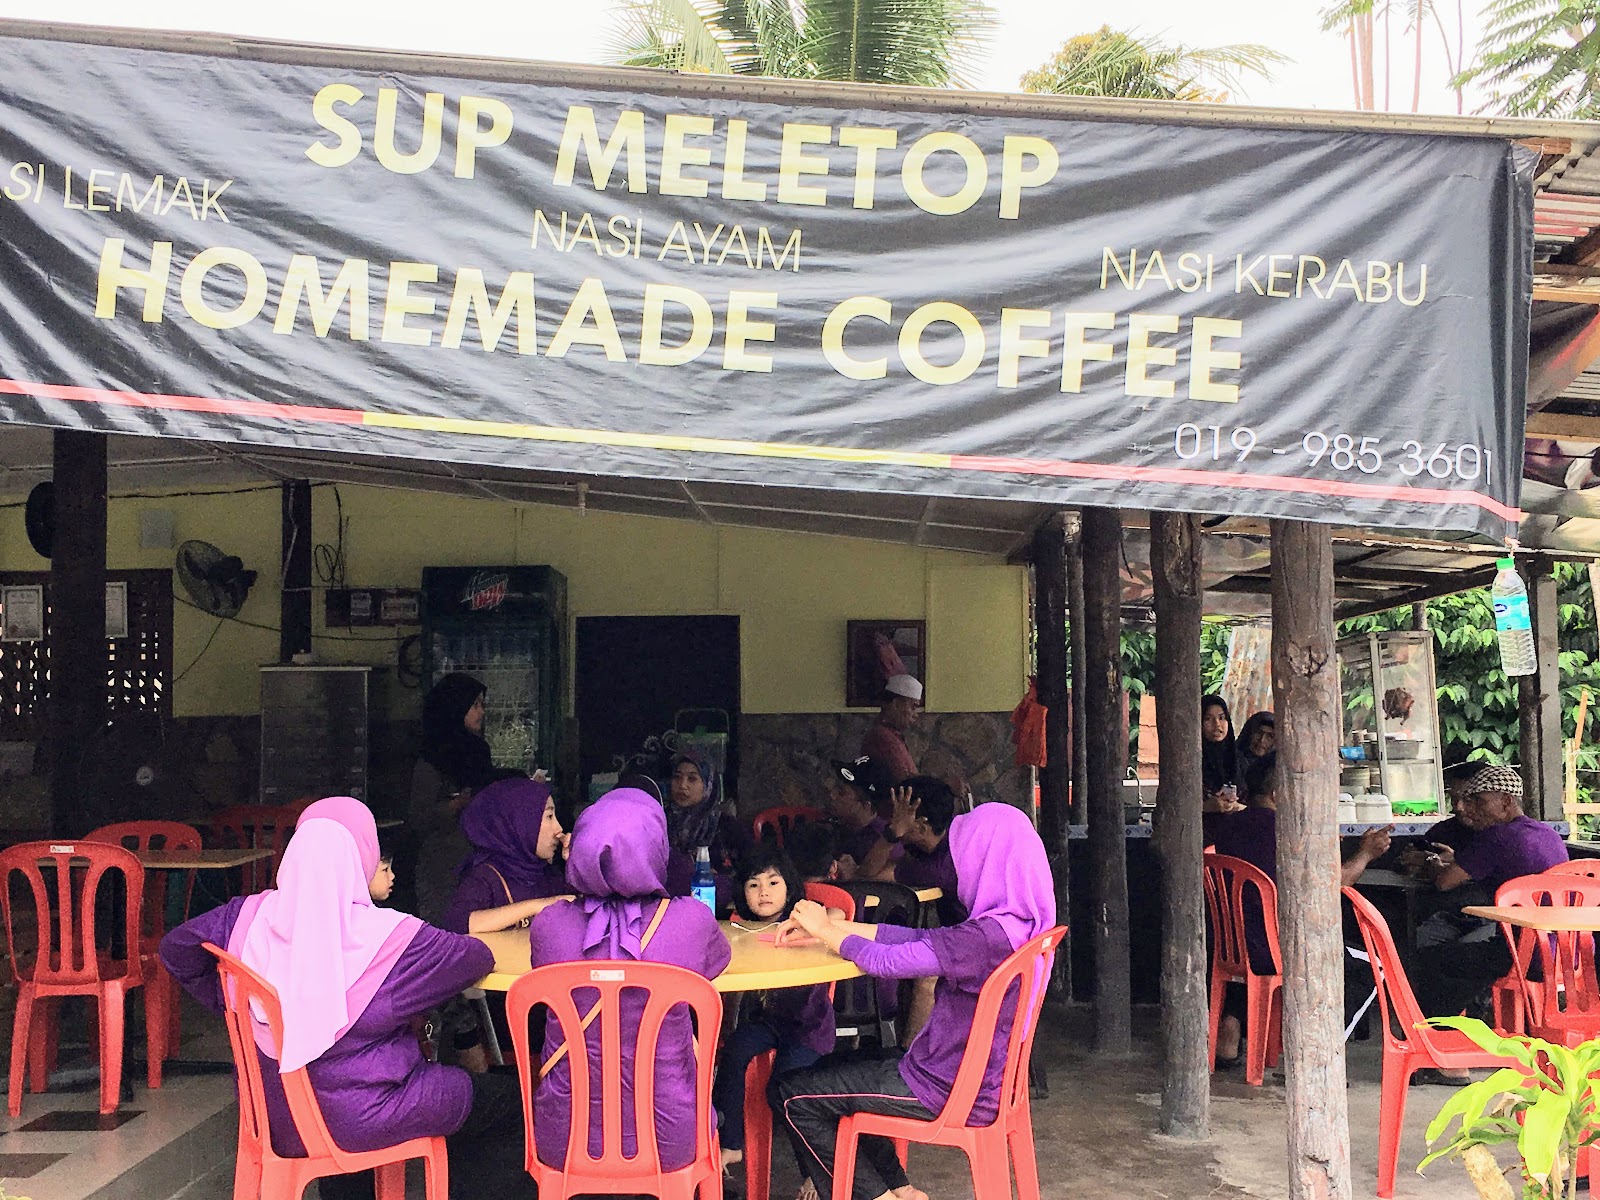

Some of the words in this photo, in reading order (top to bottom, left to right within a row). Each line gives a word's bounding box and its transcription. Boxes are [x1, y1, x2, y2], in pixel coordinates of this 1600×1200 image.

[305, 83, 515, 180] SUP
[553, 105, 1060, 220] MELETOP
[0, 161, 46, 204] SI
[63, 165, 235, 223] LEMAK
[531, 209, 642, 260] NASI
[657, 221, 802, 273] AYAM
[1100, 246, 1214, 294] NASI
[1234, 254, 1428, 307] KERABU
[95, 237, 779, 373] HOMEMADE
[820, 295, 1243, 404] COFFEE
[1174, 422, 1257, 463] 019
[1302, 431, 1383, 474] 985
[1398, 439, 1493, 486] 3601
